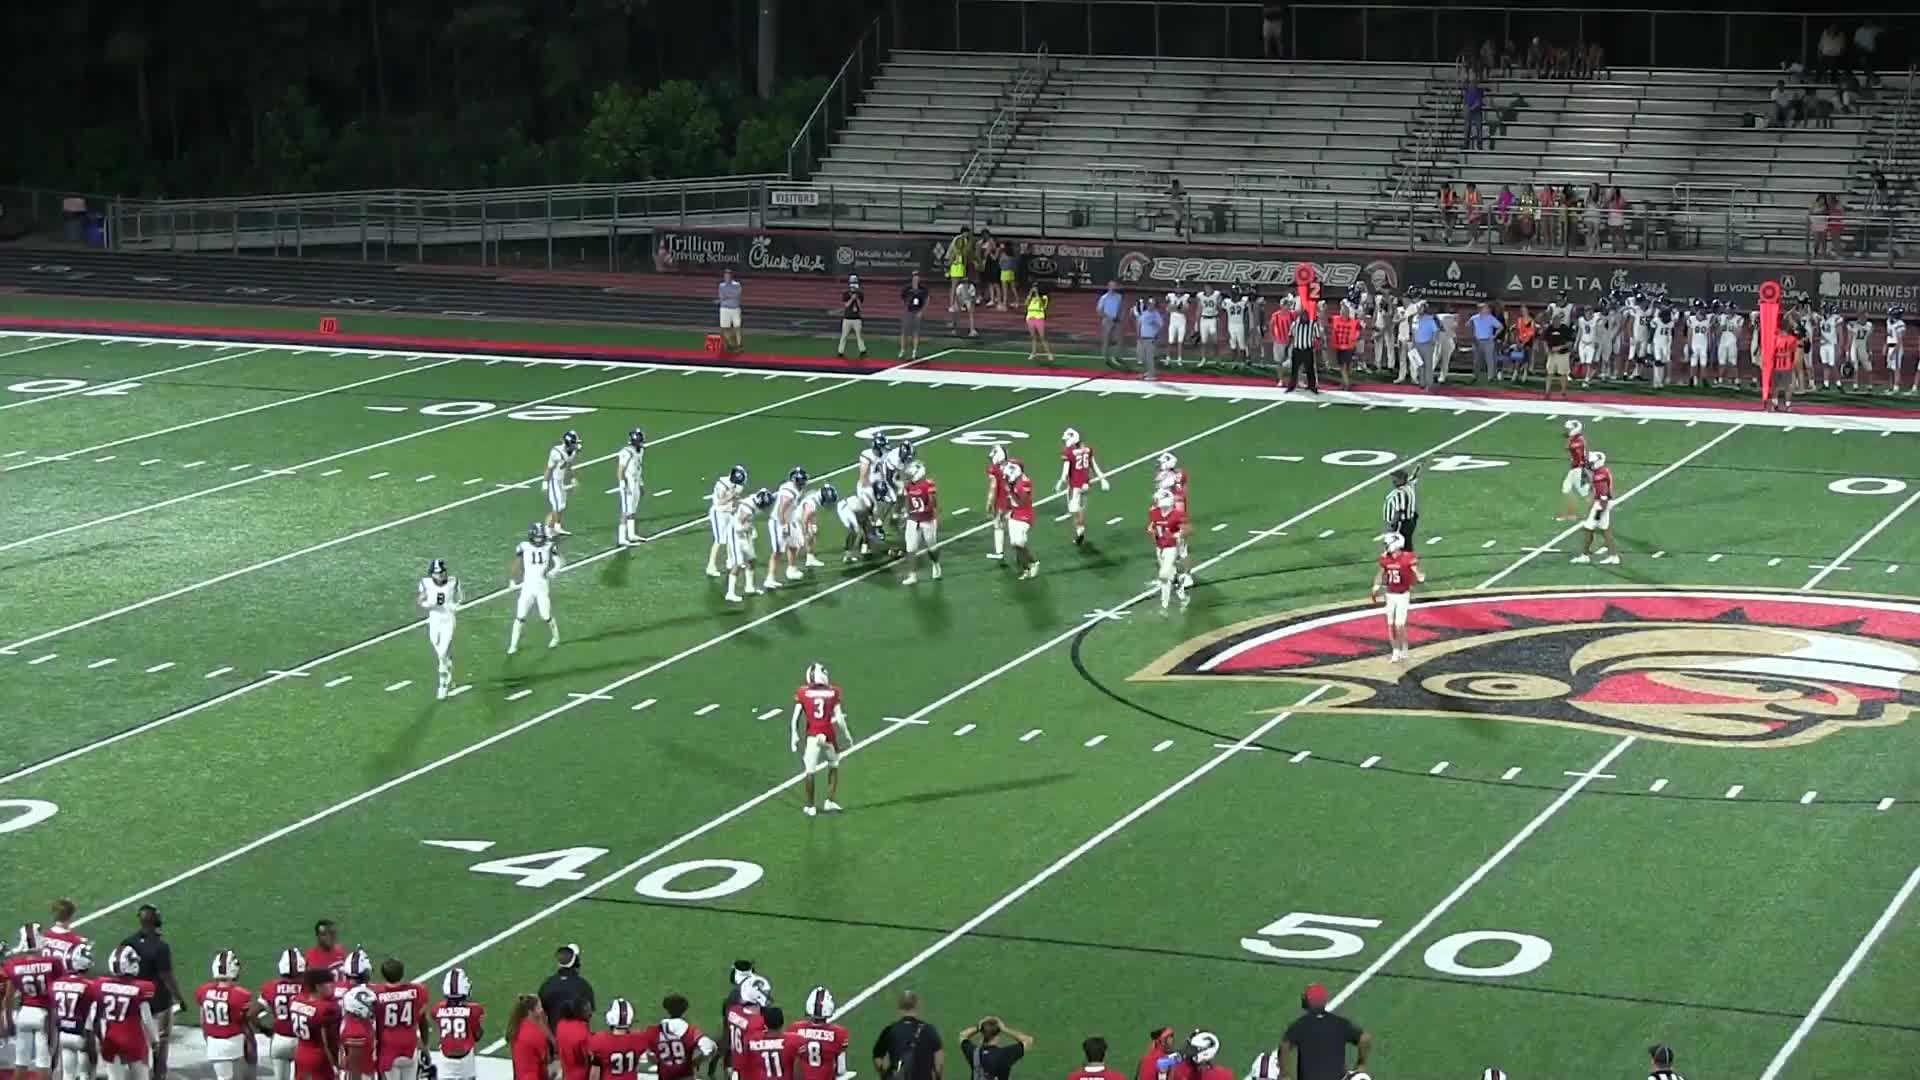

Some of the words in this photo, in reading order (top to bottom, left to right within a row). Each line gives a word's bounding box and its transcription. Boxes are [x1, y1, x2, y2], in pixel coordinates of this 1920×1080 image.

[665, 234, 725, 252] Trillium
[669, 251, 705, 263] Driving
[706, 252, 740, 263] School
[1309, 283, 1320, 299] 2
[1429, 279, 1477, 289] Georgia
[1465, 289, 1488, 298] Gas
[1530, 275, 1602, 291] DELTA
[1714, 284, 1728, 293] ED
[1840, 283, 1920, 298] NORTHWEST
[532, 551, 544, 565] 11
[813, 697, 825, 719] 3
[21, 974, 46, 997] 61
[55, 991, 80, 1018] 37
[103, 994, 130, 1022] 27
[203, 1000, 229, 1026] 60
[384, 1001, 413, 1027] 64
[436, 1006, 471, 1018] JACKSON
[729, 1024, 743, 1054] 16
[610, 1051, 635, 1074] 31
[658, 1040, 686, 1066] 29
[807, 1040, 822, 1067] 8
[761, 1051, 783, 1078] 11
